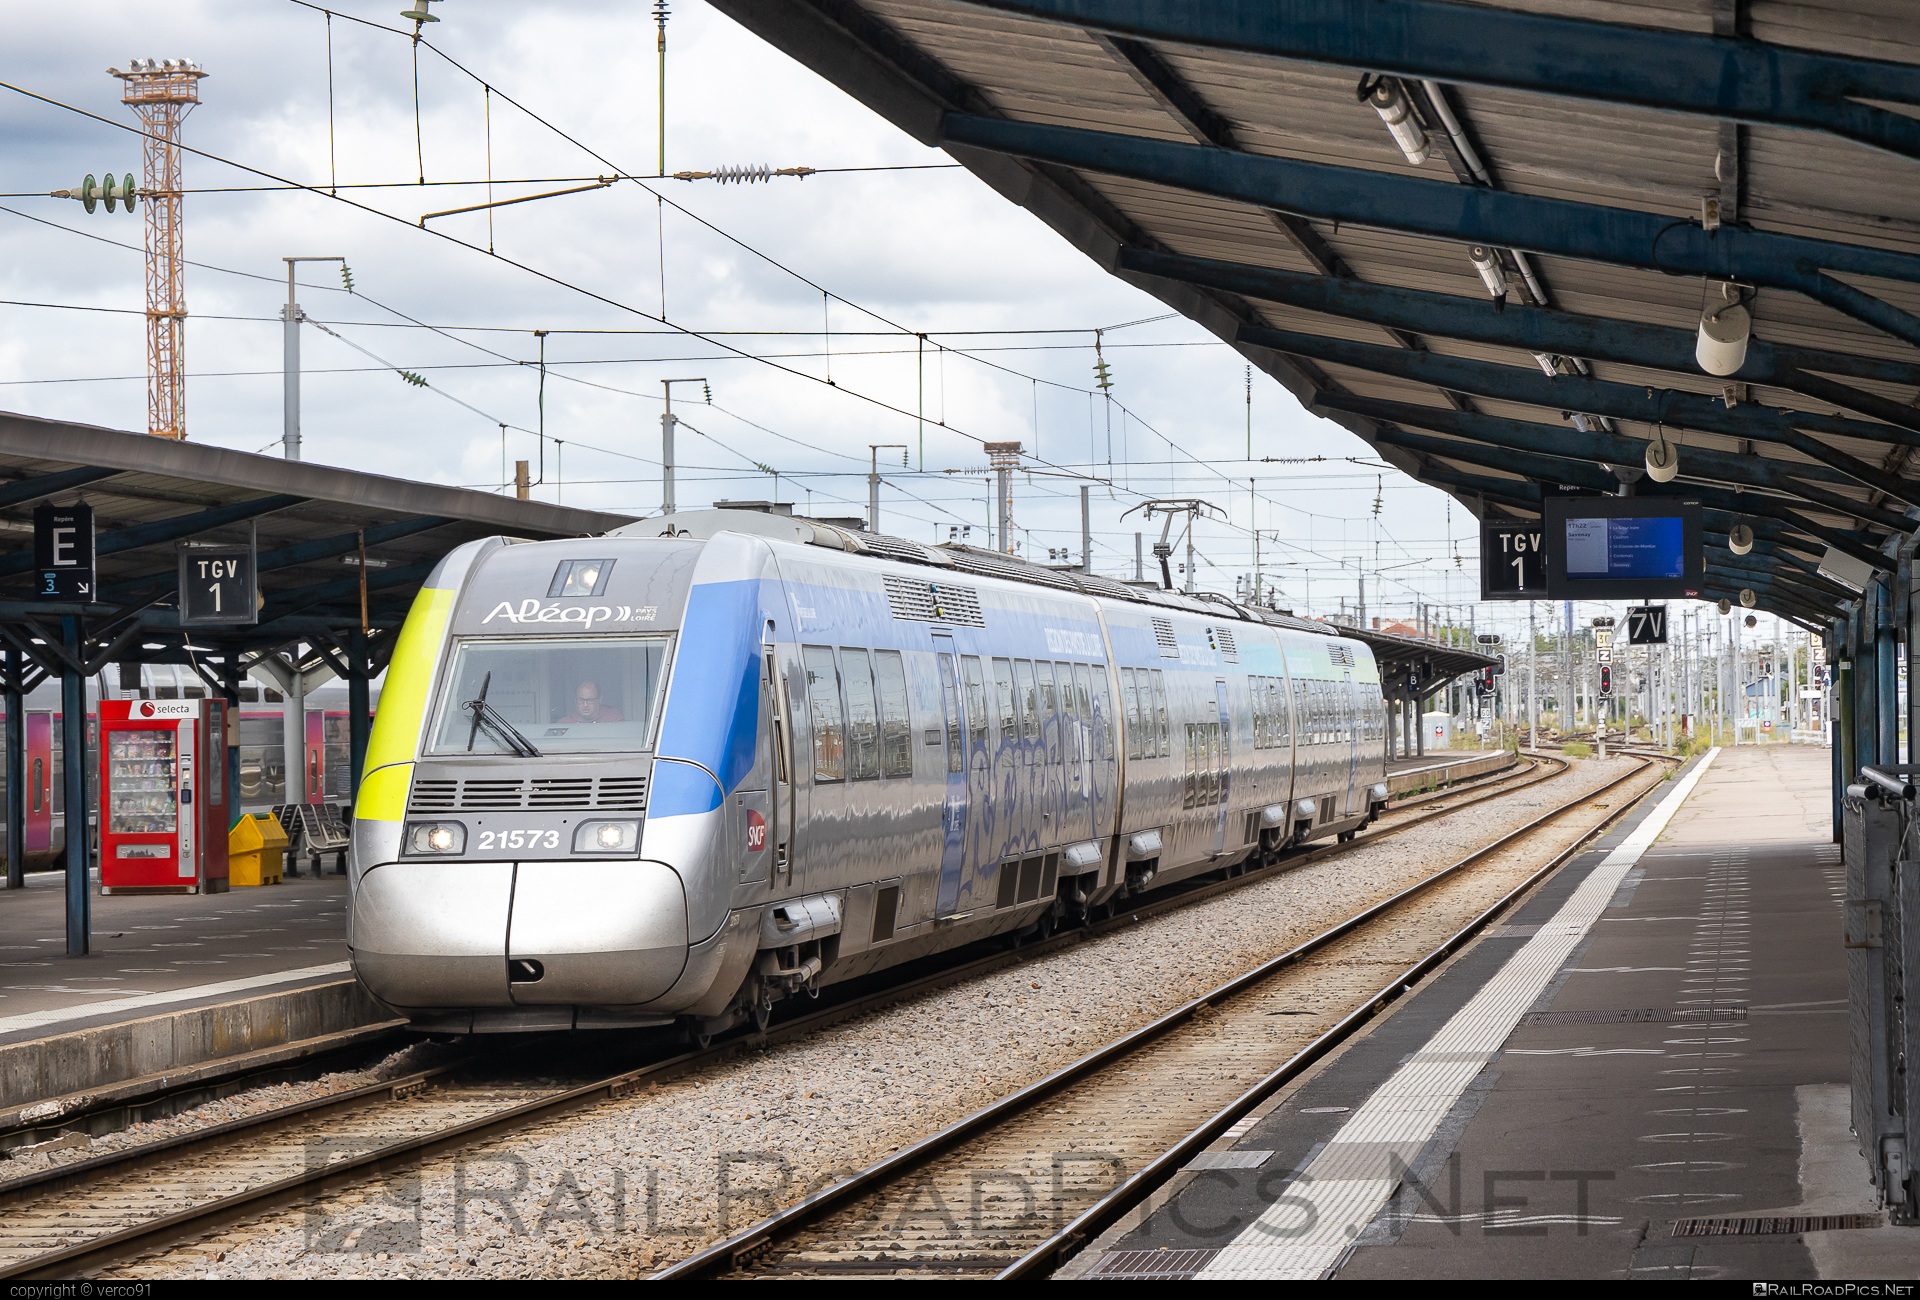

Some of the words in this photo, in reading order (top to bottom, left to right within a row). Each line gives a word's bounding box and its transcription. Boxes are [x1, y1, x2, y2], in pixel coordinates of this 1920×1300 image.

[53, 527, 77, 566] E
[1499, 533, 1541, 553] TGV
[197, 560, 237, 579] TGV
[1511, 556, 1524, 587] 1
[45, 579, 55, 592] 3
[208, 583, 221, 612] 1
[481, 599, 612, 630] Aléop
[1631, 612, 1662, 639] 7V
[157, 705, 190, 714] selecta
[477, 829, 560, 850] 21573
[748, 825, 765, 847] SNCF
